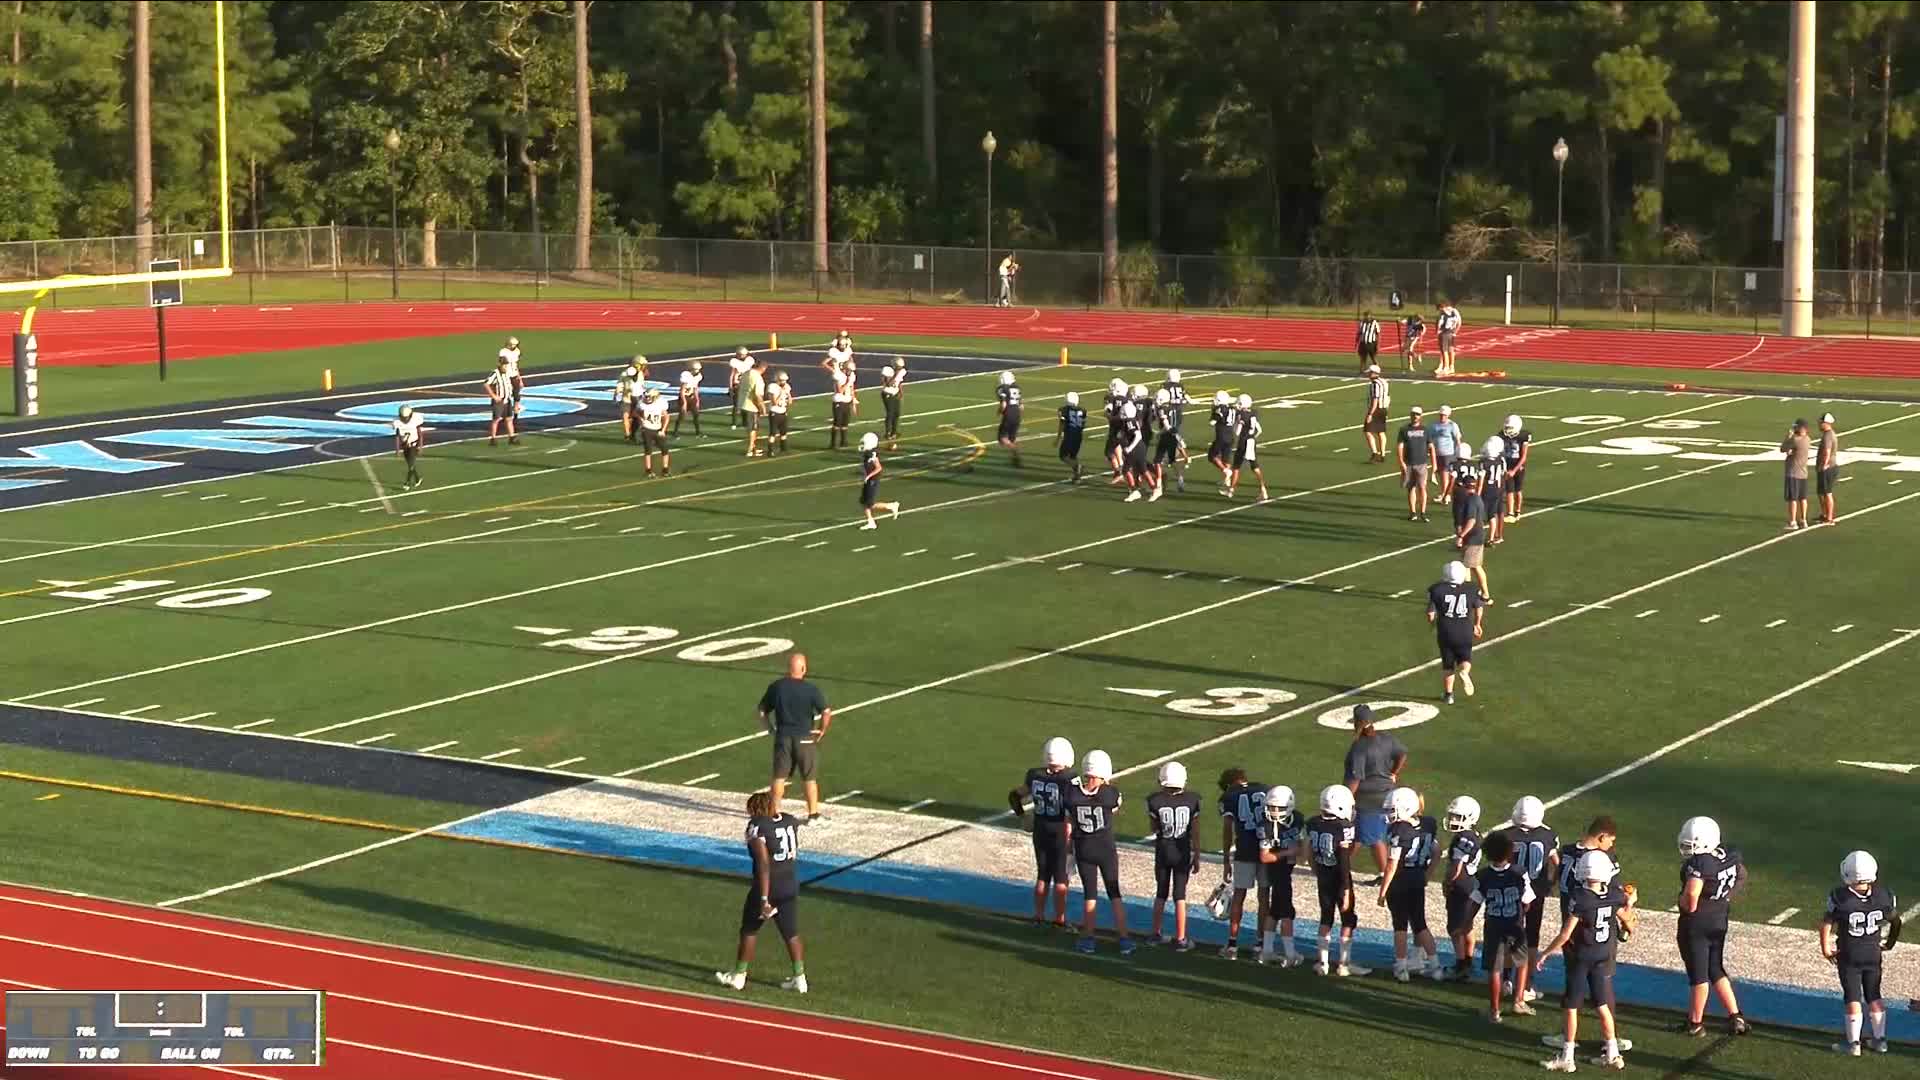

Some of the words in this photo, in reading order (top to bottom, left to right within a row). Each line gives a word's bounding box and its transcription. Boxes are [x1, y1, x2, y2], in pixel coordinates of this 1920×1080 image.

[0, 379, 738, 490] YNOR
[1444, 593, 1467, 618] 74
[537, 625, 792, 661] 20
[1161, 686, 1438, 730] 30
[1031, 779, 1060, 816] 53
[1077, 805, 1104, 833] 51
[773, 824, 797, 861] 31
[1487, 886, 1519, 917] 20
[1594, 905, 1612, 943] 5
